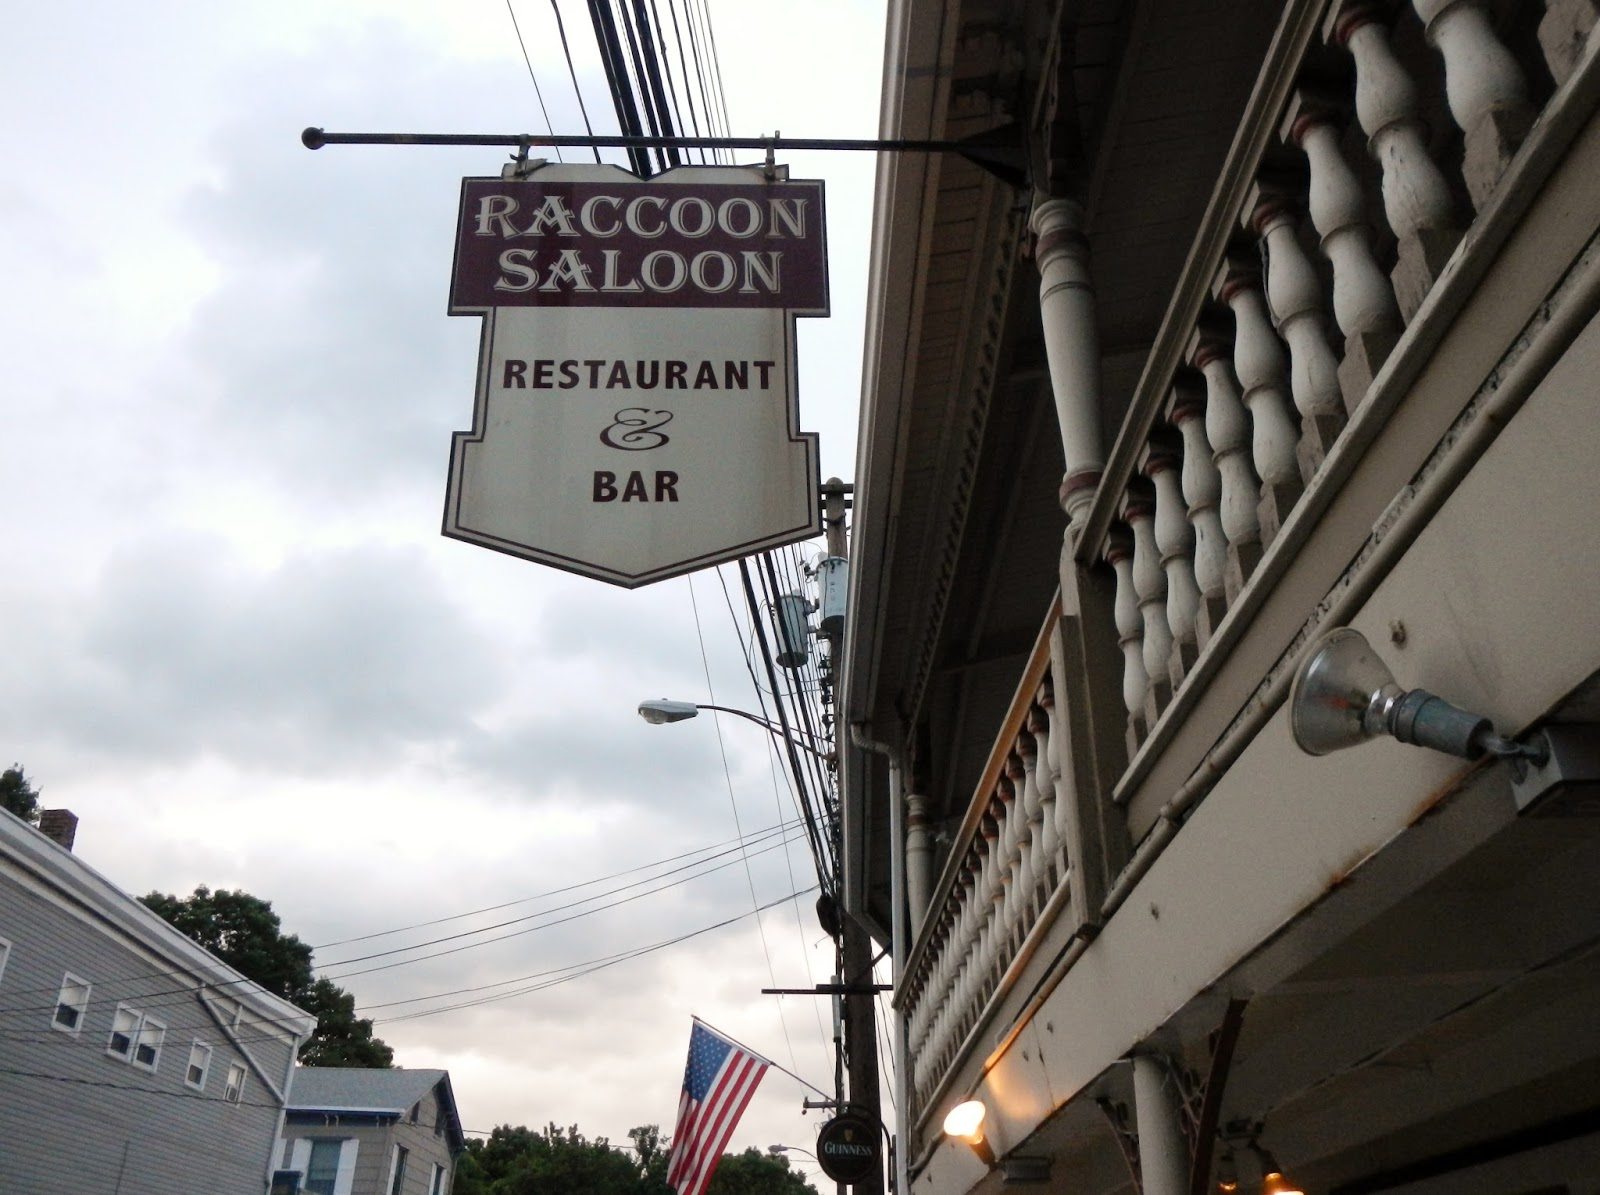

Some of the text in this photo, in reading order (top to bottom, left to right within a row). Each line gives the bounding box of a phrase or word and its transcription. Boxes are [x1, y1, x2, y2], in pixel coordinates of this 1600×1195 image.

[474, 194, 811, 240] RACCOON
[493, 249, 783, 294] SALOON
[503, 359, 776, 390] RESTAURANT
[600, 407, 674, 451] &
[593, 470, 679, 502] BAR
[824, 1141, 872, 1156] GUINNESS
